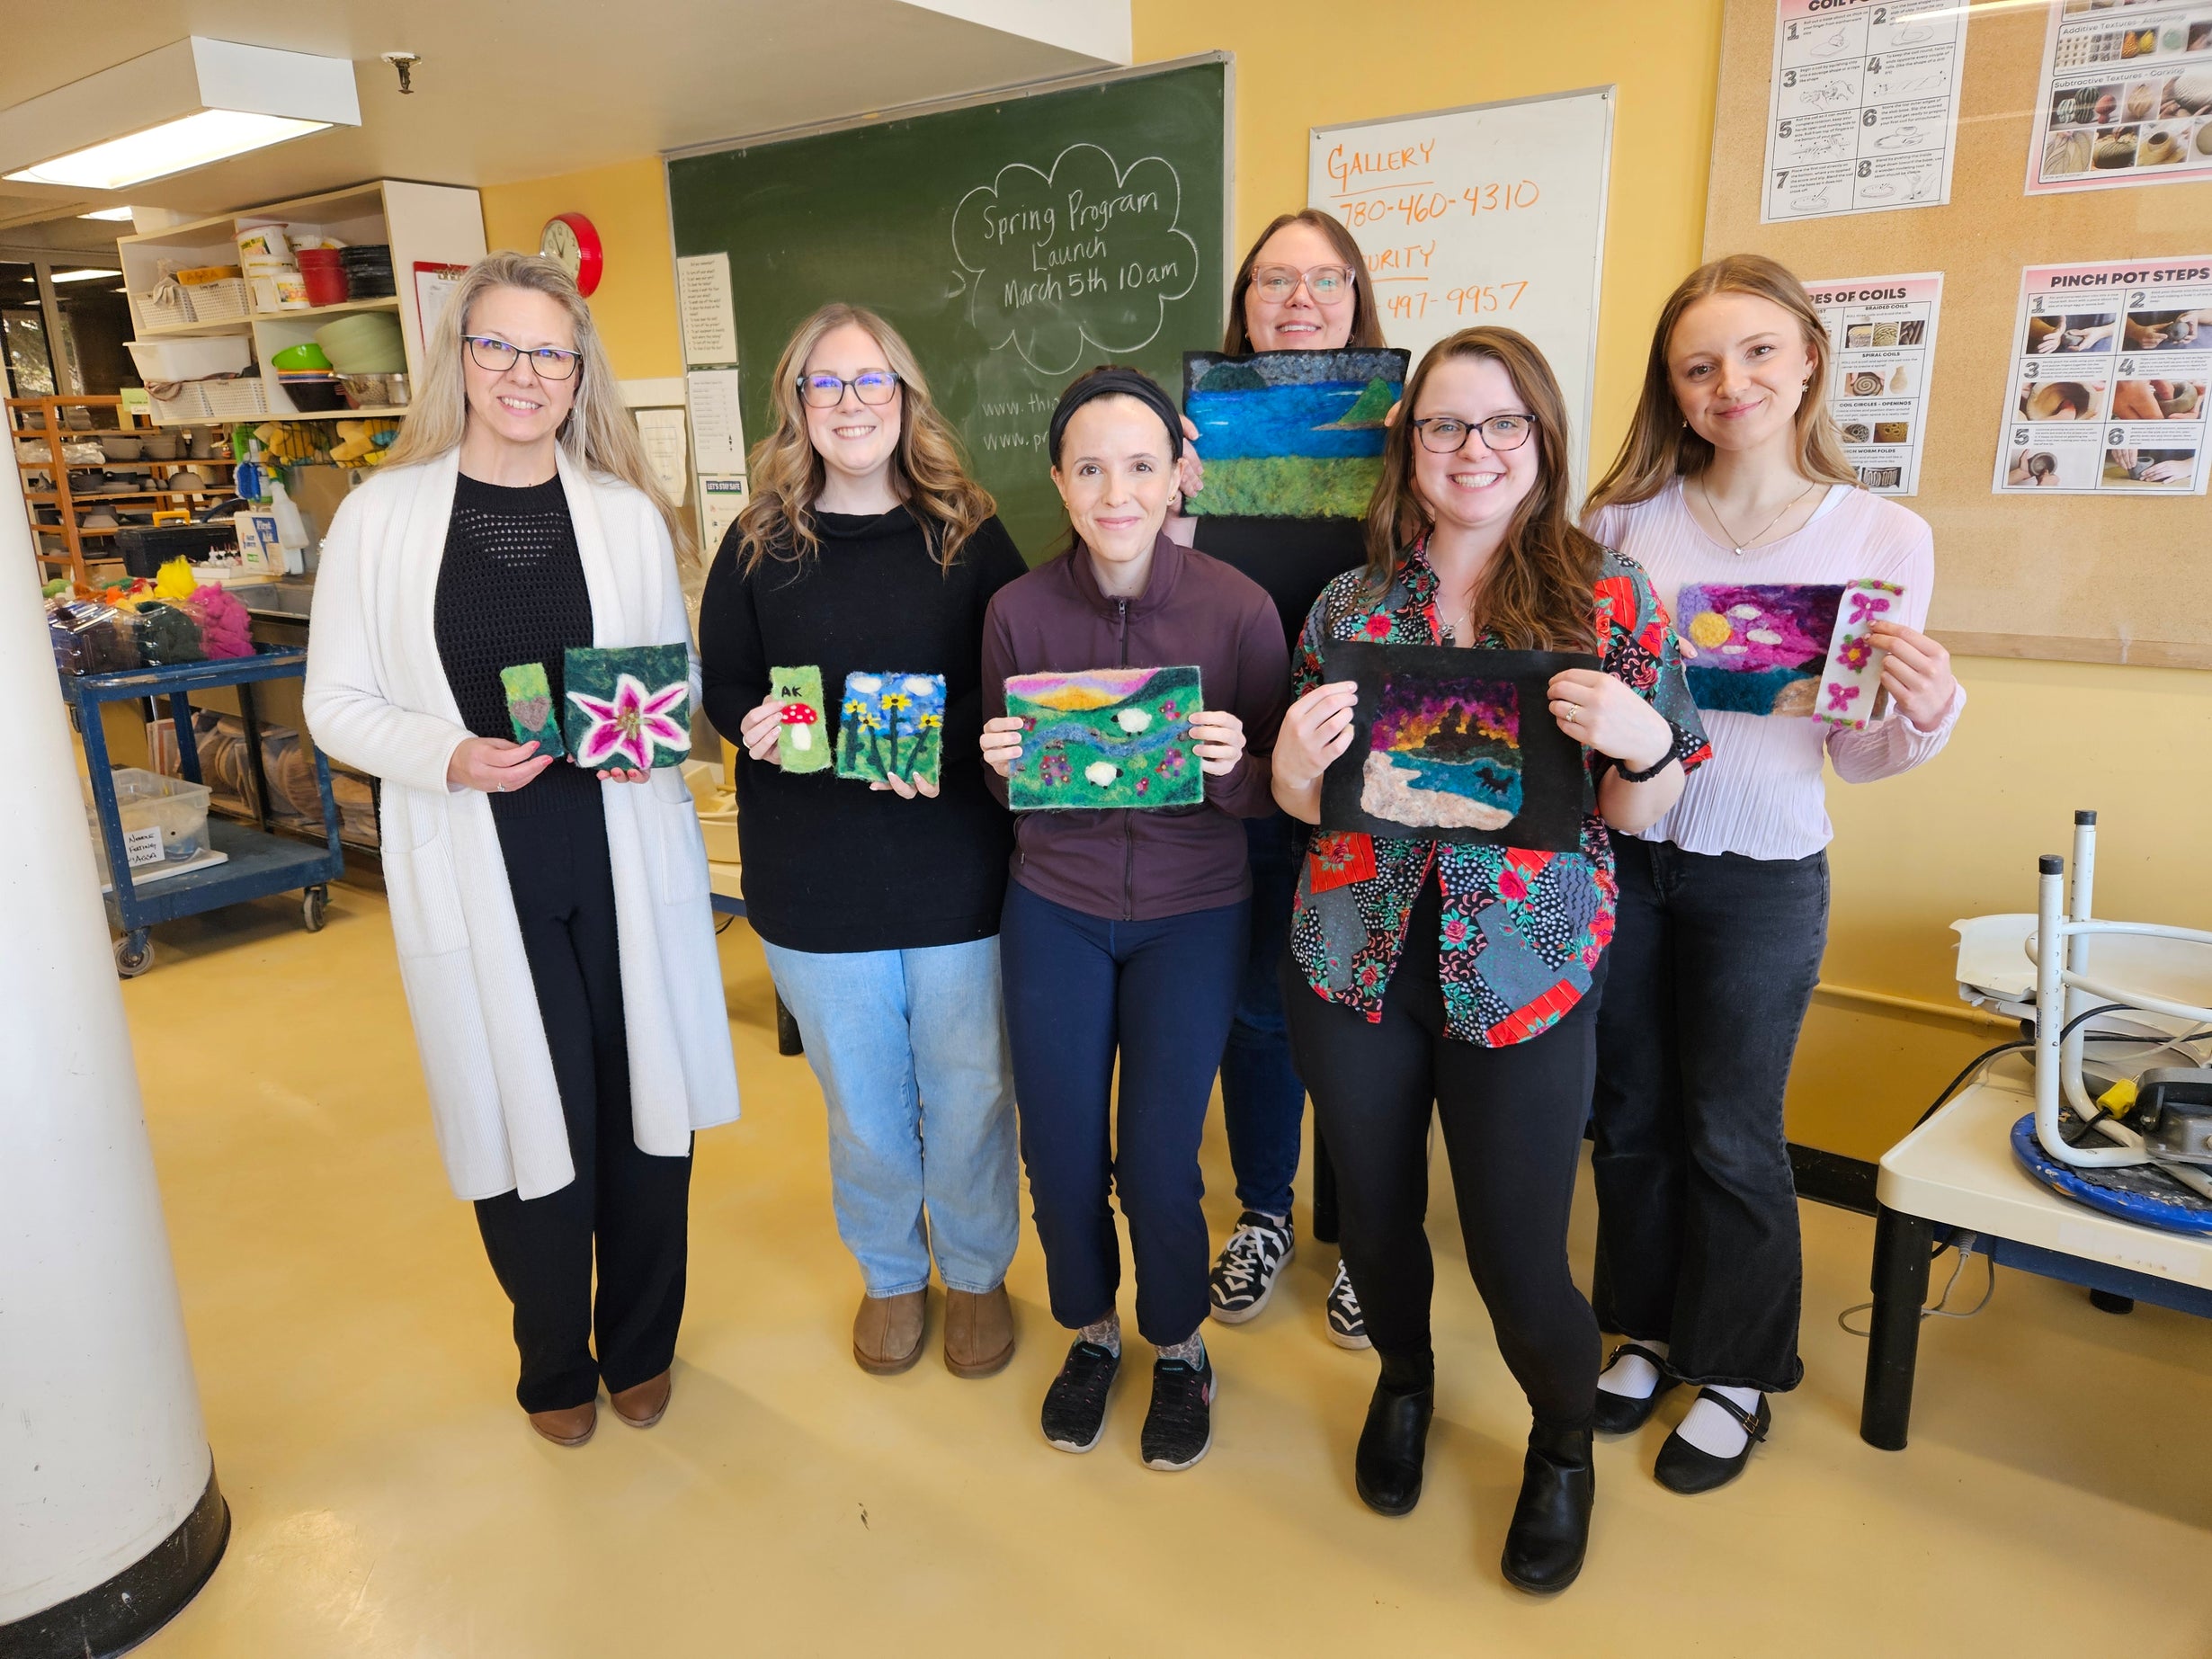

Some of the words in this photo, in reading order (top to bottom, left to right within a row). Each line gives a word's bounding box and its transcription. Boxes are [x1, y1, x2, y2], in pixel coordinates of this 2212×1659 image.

[1873, 8, 1887, 25] 2
[1788, 22, 1799, 40] 1
[2063, 25, 2100, 34] Additive
[1867, 57, 1882, 74] 4
[1783, 70, 1797, 87] 3
[2055, 77, 2103, 88] Subtractive
[2107, 73, 2142, 83] Textures
[1863, 109, 1878, 127] 6
[1779, 120, 1792, 138] 5
[1327, 138, 1435, 192] GALLERY
[1857, 160, 1871, 177] 8
[1776, 171, 1789, 189] 7
[1340, 180, 1539, 228] 780-460-4310
[984, 205, 1055, 247] Spring
[1068, 189, 1158, 232] Program
[1032, 236, 1107, 272] Launch
[1363, 239, 1436, 272] URITY
[2050, 272, 2108, 287] PINCH
[2111, 271, 2149, 285] POT
[2153, 267, 2210, 282] STEPS
[1004, 273, 1061, 308] March
[1068, 268, 1107, 297] 5th
[1835, 291, 1856, 302] OF
[1859, 288, 1906, 300] COILS
[2031, 296, 2045, 313] 1
[2129, 291, 2145, 308] 2
[2023, 361, 2039, 379] 3
[2118, 359, 2135, 376] 4
[2014, 429, 2029, 445] 5
[2109, 428, 2124, 445] 6
[781, 685, 802, 698] AK
